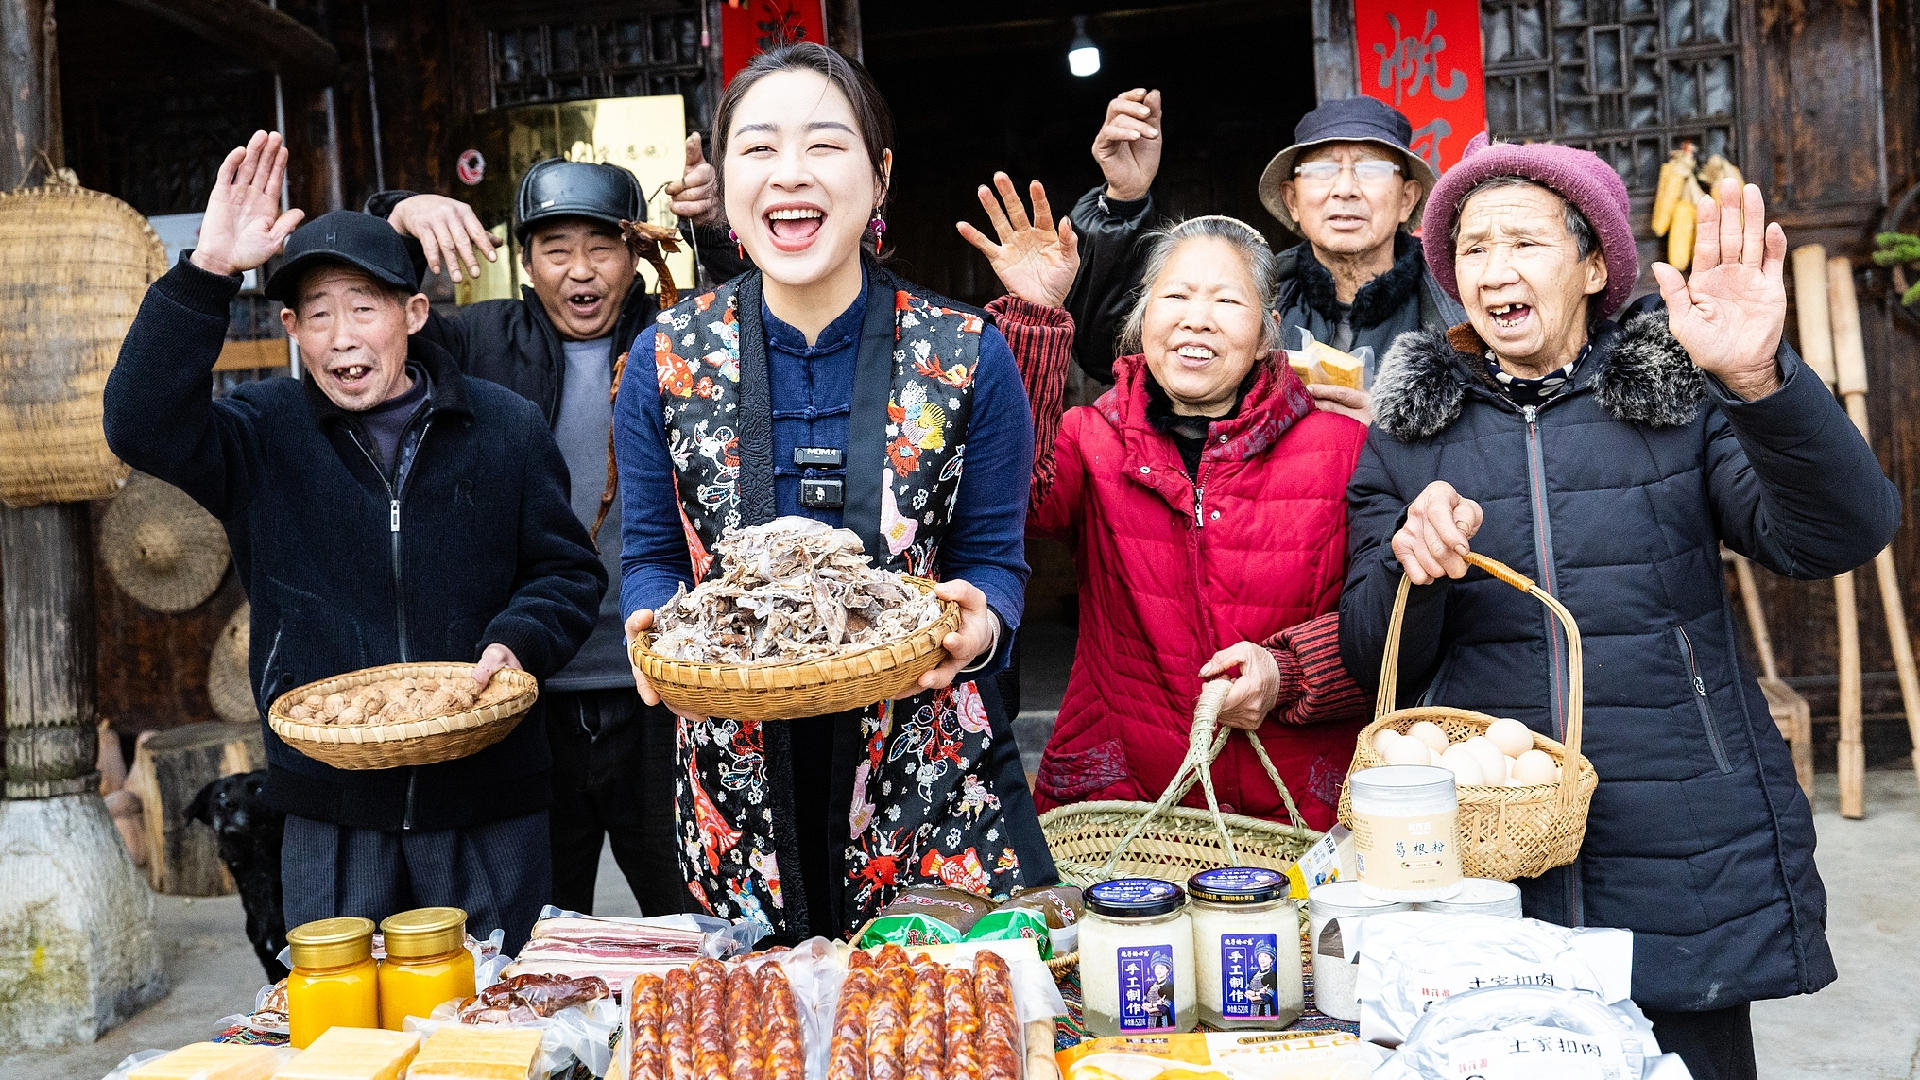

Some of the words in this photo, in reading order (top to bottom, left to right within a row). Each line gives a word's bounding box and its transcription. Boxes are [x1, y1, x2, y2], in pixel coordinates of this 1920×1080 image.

[1396, 840, 1445, 858] 葛根粉
[1124, 962, 1141, 1016] 手工制作
[1228, 950, 1244, 1003] 手工制作
[1509, 1036, 1602, 1057] 土家扣肉
